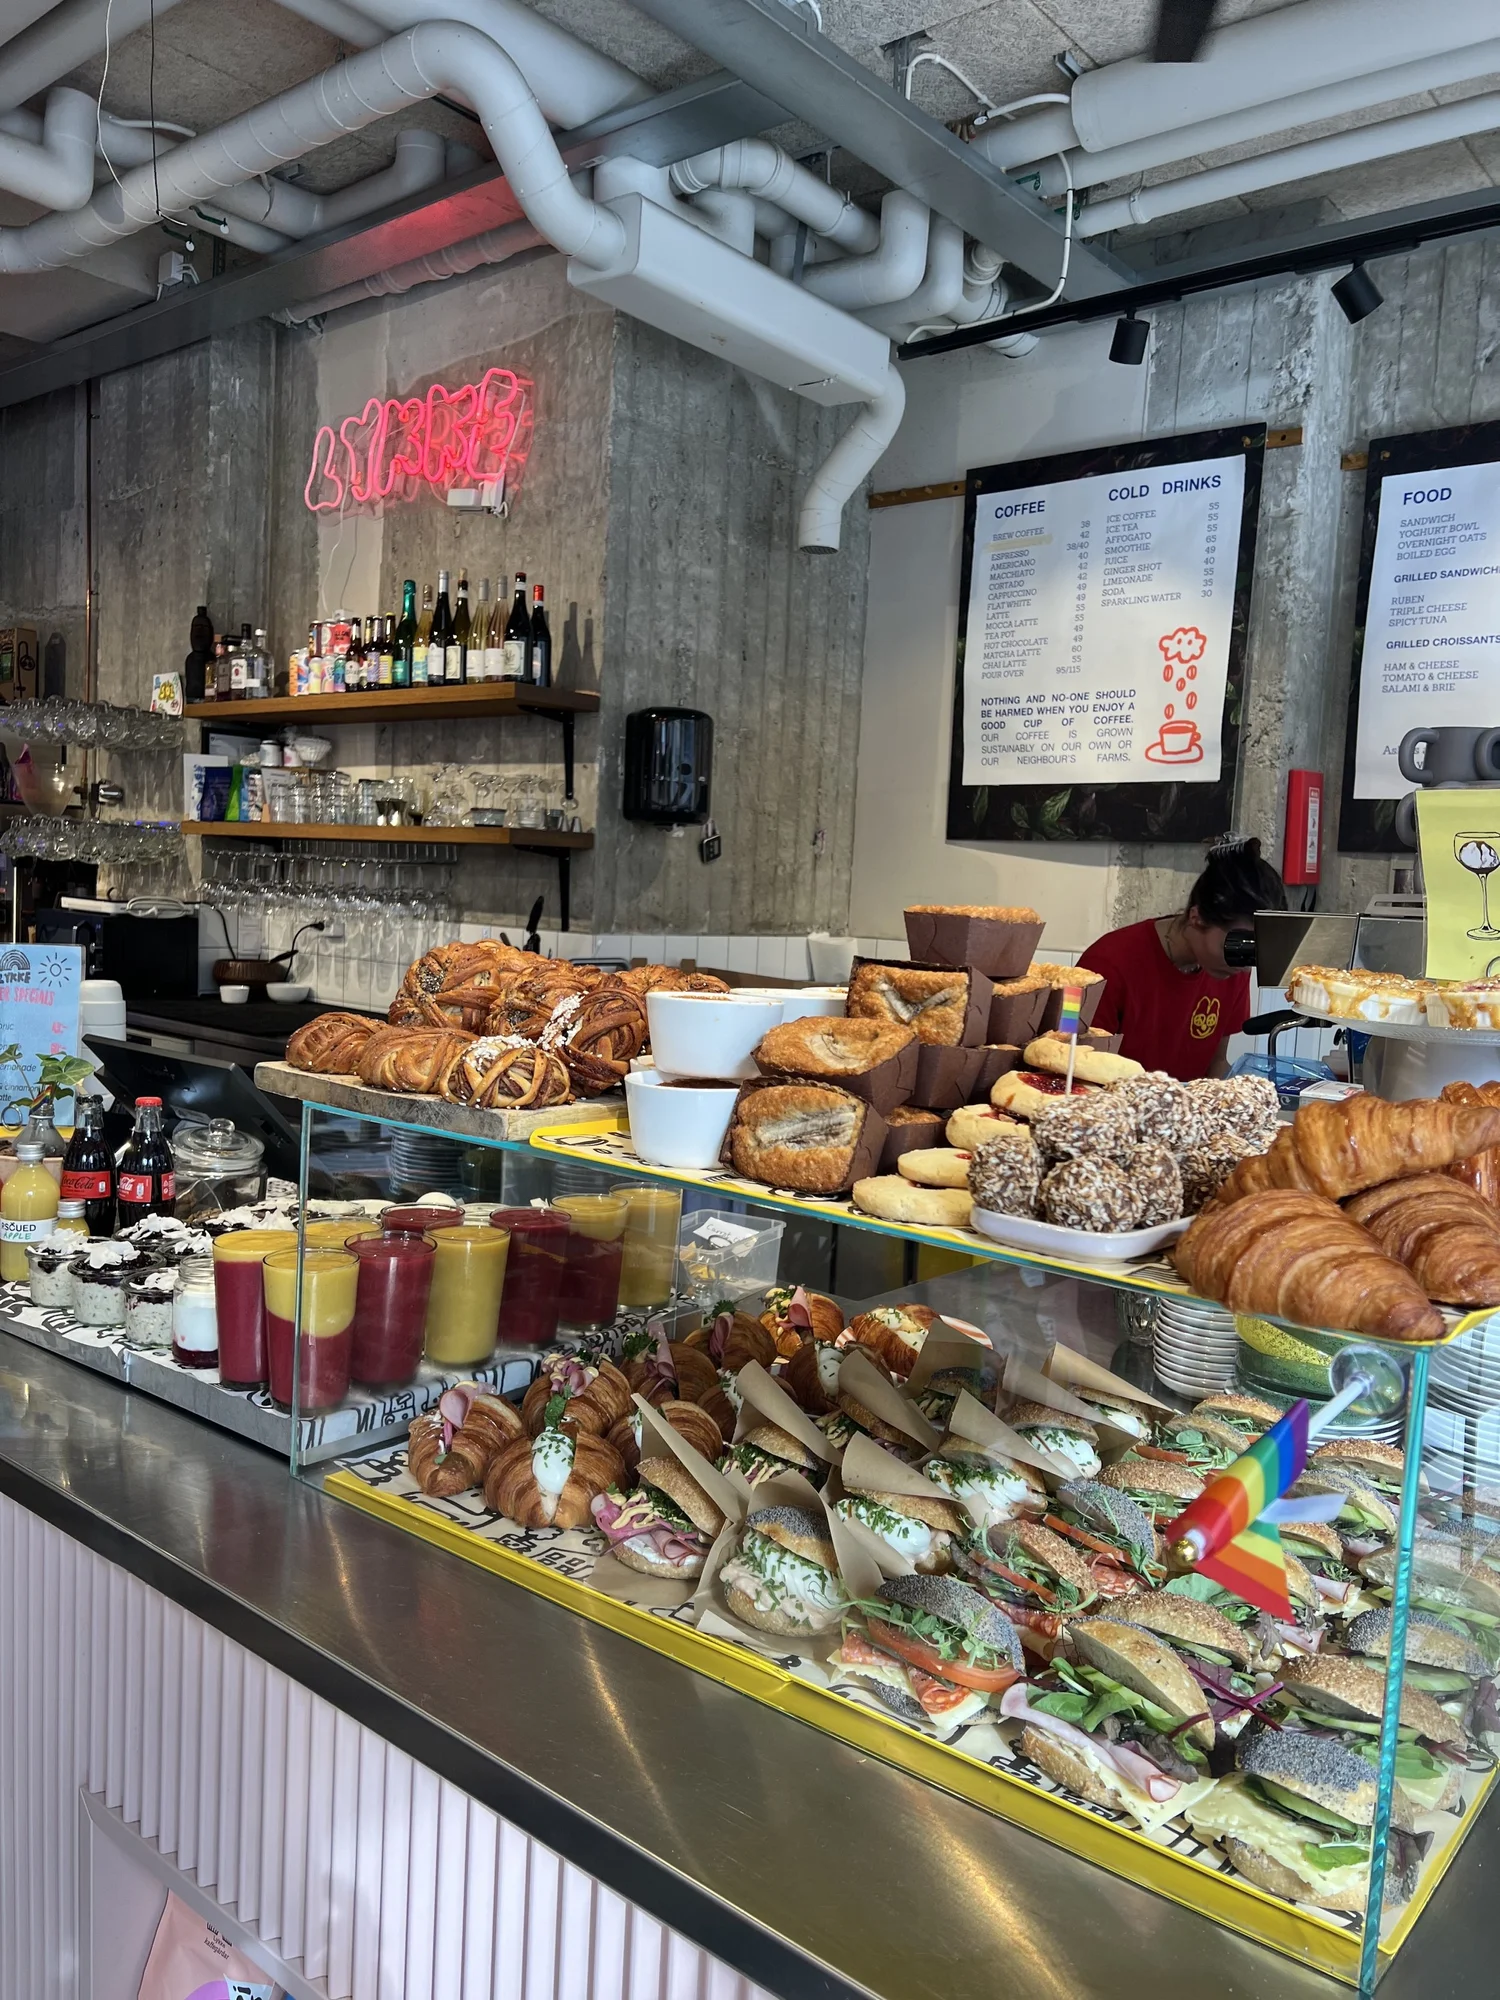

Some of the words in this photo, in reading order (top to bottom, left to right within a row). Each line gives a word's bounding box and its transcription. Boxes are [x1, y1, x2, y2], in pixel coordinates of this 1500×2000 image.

[1109, 485, 1149, 501] COLD
[1162, 475, 1221, 494] DRINKS
[1403, 488, 1452, 505] FOOD
[995, 500, 1045, 519] COFFEE
[1106, 514, 1121, 523] ICE
[1122, 510, 1156, 520] COFFEE
[1209, 502, 1220, 511] 55
[1106, 525, 1120, 534] ICE
[1122, 523, 1138, 532] TEA
[1207, 513, 1219, 521] 55
[1400, 513, 1456, 527] SANDWICH
[993, 531, 1014, 541] BREW
[1014, 527, 1045, 538] COFFEE
[1081, 520, 1091, 529] 38
[1080, 531, 1089, 539] 42
[1105, 532, 1152, 544] AFFOGATO
[1207, 524, 1218, 532] 55
[1399, 525, 1448, 539] YOGHURT
[1449, 522, 1480, 533] BOWL
[1104, 542, 1151, 555] SMOOTHIE
[1205, 535, 1217, 543] 65
[1397, 535, 1457, 549] OVERNIGHT
[1459, 532, 1487, 543] OATS
[991, 549, 1030, 561] ESPRESSO
[1066, 541, 1089, 551] 38/40
[1103, 555, 1129, 565] JUICE
[1204, 546, 1216, 554] 49
[1396, 549, 1432, 561] BOILED
[1434, 547, 1456, 557] EGG
[990, 558, 1036, 571] AMERICANO
[1078, 551, 1089, 560] 40
[1103, 565, 1136, 576] GINGER
[1137, 562, 1162, 572] SHOT
[1203, 556, 1215, 565] 40
[989, 568, 1035, 581] MACCHIATO
[1078, 562, 1088, 570] 42
[1203, 567, 1214, 576] 55
[1394, 571, 1437, 583] GRILLED
[1440, 565, 1500, 579] SANDWICH
[988, 580, 1025, 591] CORTADO
[1077, 572, 1088, 580] 42
[1101, 587, 1125, 597] SODA
[1202, 578, 1213, 587] 35
[987, 588, 1037, 601] CAPPUCCINO
[1076, 583, 1087, 591] 49
[1100, 595, 1149, 607] SPARKLING
[1151, 592, 1181, 602] WATER
[1200, 589, 1212, 598] 30
[1391, 595, 1425, 605] RUBEN
[987, 602, 1006, 611] FLAT
[1006, 599, 1031, 608] WHITE
[1076, 593, 1086, 602] 49
[1390, 606, 1424, 616] TRIPLE
[1426, 602, 1468, 613] CHEESE
[986, 611, 1010, 620] LATTE
[1075, 604, 1085, 612] 55
[985, 621, 1013, 630] MOCCA
[1013, 618, 1038, 628] LATTE
[1074, 614, 1084, 622] 55
[1388, 617, 1418, 627] SPICY
[1419, 615, 1447, 625] TUNA
[984, 632, 999, 640] TEA
[1000, 630, 1015, 639] POT
[1073, 624, 1083, 633] 49
[984, 642, 1000, 650] HOT
[1000, 637, 1048, 648] CHOCOLATE
[1073, 634, 1083, 643] 49
[1386, 639, 1430, 649] GRILLED
[1433, 635, 1500, 647] CROISSANTS
[983, 650, 1015, 660] MATCHA
[1016, 648, 1041, 657] LATTE
[1071, 645, 1082, 653] 60
[982, 661, 1001, 670] CHAI
[1002, 659, 1027, 668] LATTE
[1071, 655, 1082, 663] 55
[1384, 662, 1407, 671] HAM
[1418, 660, 1460, 670] CHEESE
[981, 671, 1002, 680] POUR
[1003, 669, 1024, 678] OVER
[1383, 673, 1426, 683] TOMATO
[1428, 673, 1434, 681] &
[1437, 671, 1479, 681] CHEESE
[1382, 684, 1421, 693] SALAMI
[1423, 684, 1429, 692] &
[1432, 682, 1456, 692] BRIE
[981, 696, 1020, 706] NOTHING
[1026, 694, 1045, 704] AND
[1052, 692, 1090, 702] NO-ONE
[1095, 689, 1136, 700] SHOULD
[981, 709, 992, 718] BE
[995, 707, 1033, 718] HARMED
[1037, 706, 1065, 715] WHEN
[1068, 704, 1089, 714] YOU
[1093, 702, 1124, 713] ENJOY
[1128, 702, 1135, 711] A
[981, 721, 1006, 730] GOOD
[1023, 719, 1042, 728] CUP
[1061, 717, 1075, 726] OF
[1093, 715, 1133, 725] COFFEE.
[981, 733, 999, 742] OUR
[1015, 731, 1049, 740] COFFEE
[1068, 729, 1077, 738] IS
[1097, 727, 1133, 738] GROWN
[981, 744, 1035, 754] SUSTAINABLY
[1041, 743, 1055, 752] ON
[1061, 742, 1081, 751] OUR
[1088, 740, 1111, 750] OWN
[1118, 740, 1132, 749] OR
[981, 757, 999, 766] OUR
[1017, 754, 1076, 765] NEIGHBOUR'S
[1097, 752, 1131, 763] FARMS.
[14, 986, 55, 1006] SPECIALS
